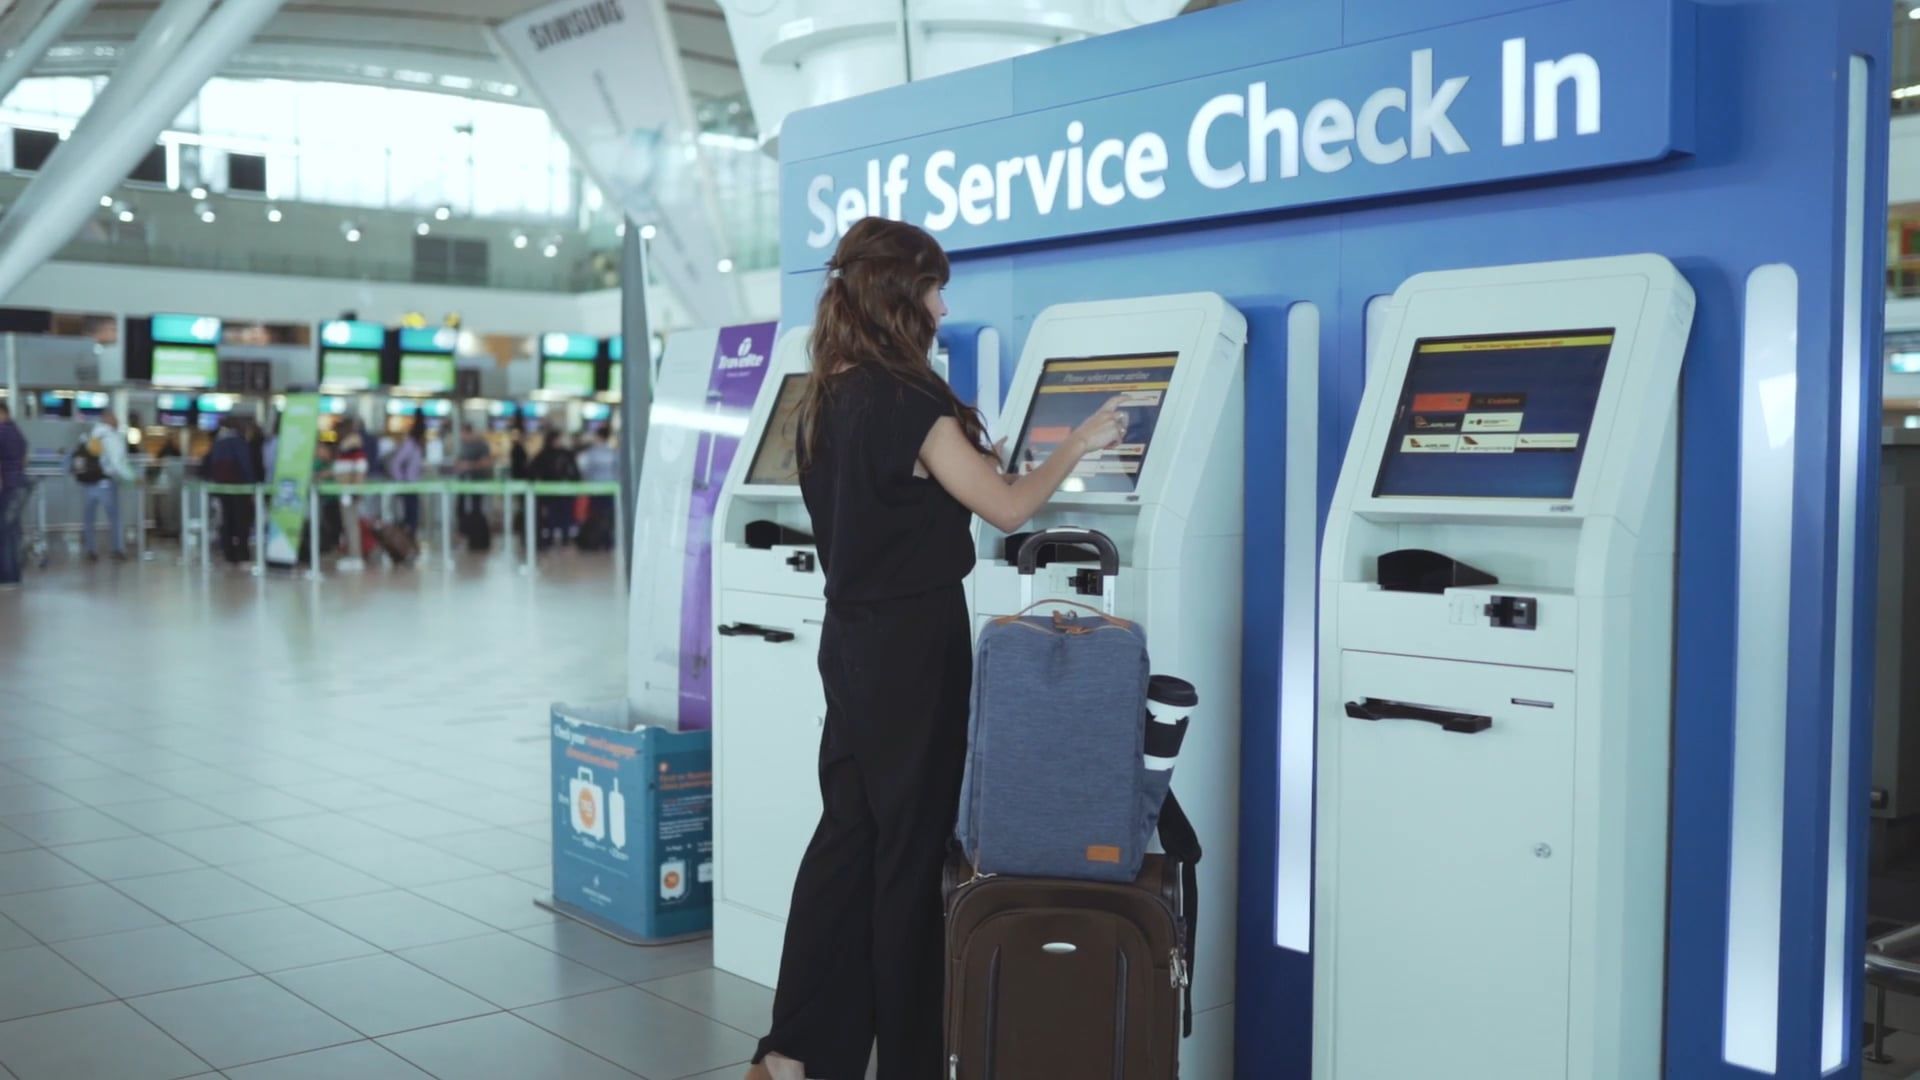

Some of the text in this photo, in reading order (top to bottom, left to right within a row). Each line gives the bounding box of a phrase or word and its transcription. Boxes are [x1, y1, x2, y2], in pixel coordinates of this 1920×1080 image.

[528, 0, 624, 51] SAMSUNG
[807, 37, 1600, 249] Self Service Check In
